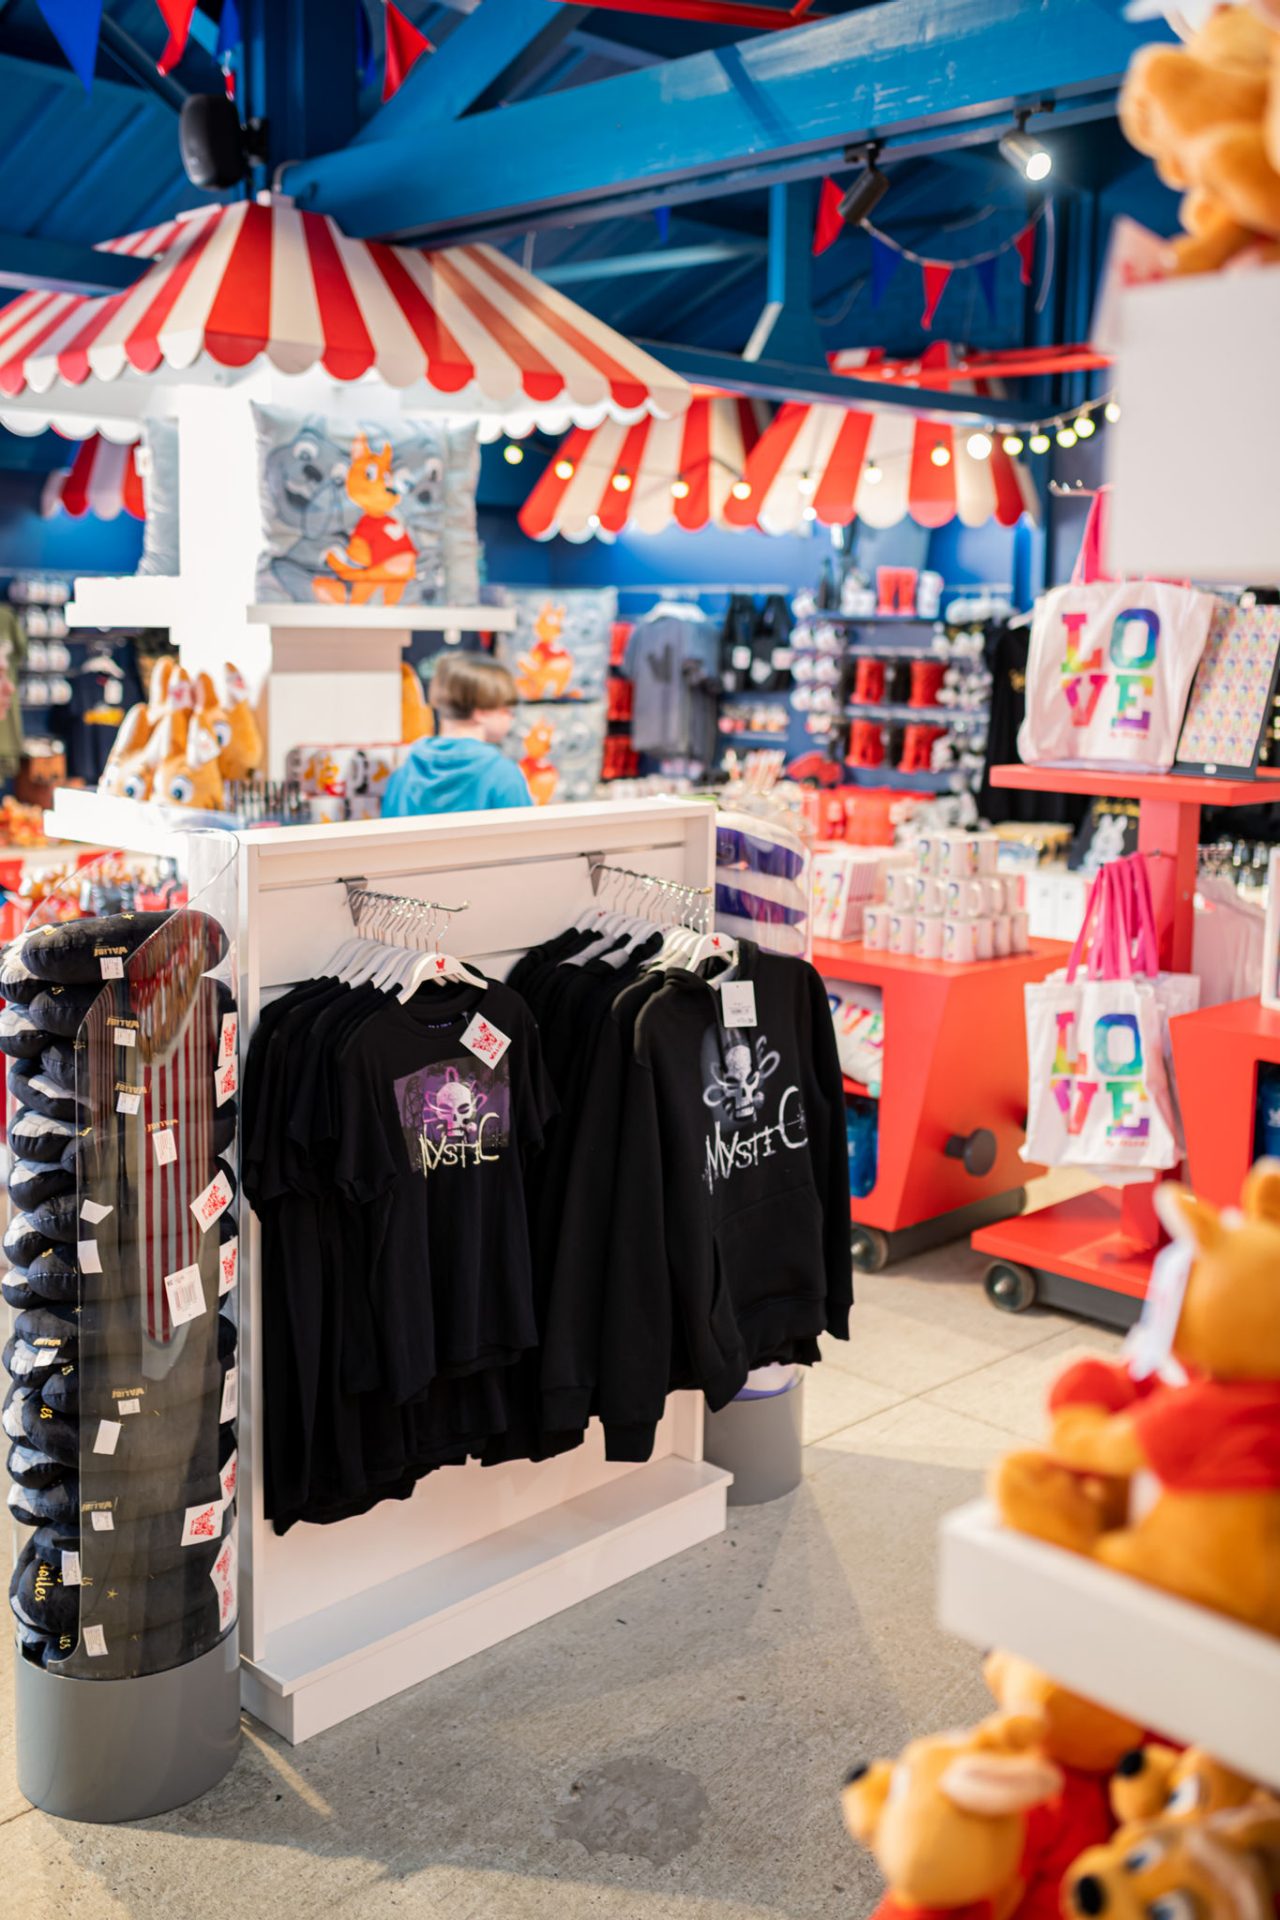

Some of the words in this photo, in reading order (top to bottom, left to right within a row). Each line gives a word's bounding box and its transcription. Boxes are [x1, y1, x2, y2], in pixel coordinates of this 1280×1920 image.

[93, 946, 128, 957] WALIBI
[106, 1017, 139, 1028] WALIBI
[419, 1112, 500, 1178] MYSTIC
[705, 1086, 808, 1195] MYSTIC
[111, 1387, 144, 1398] WALIBI
